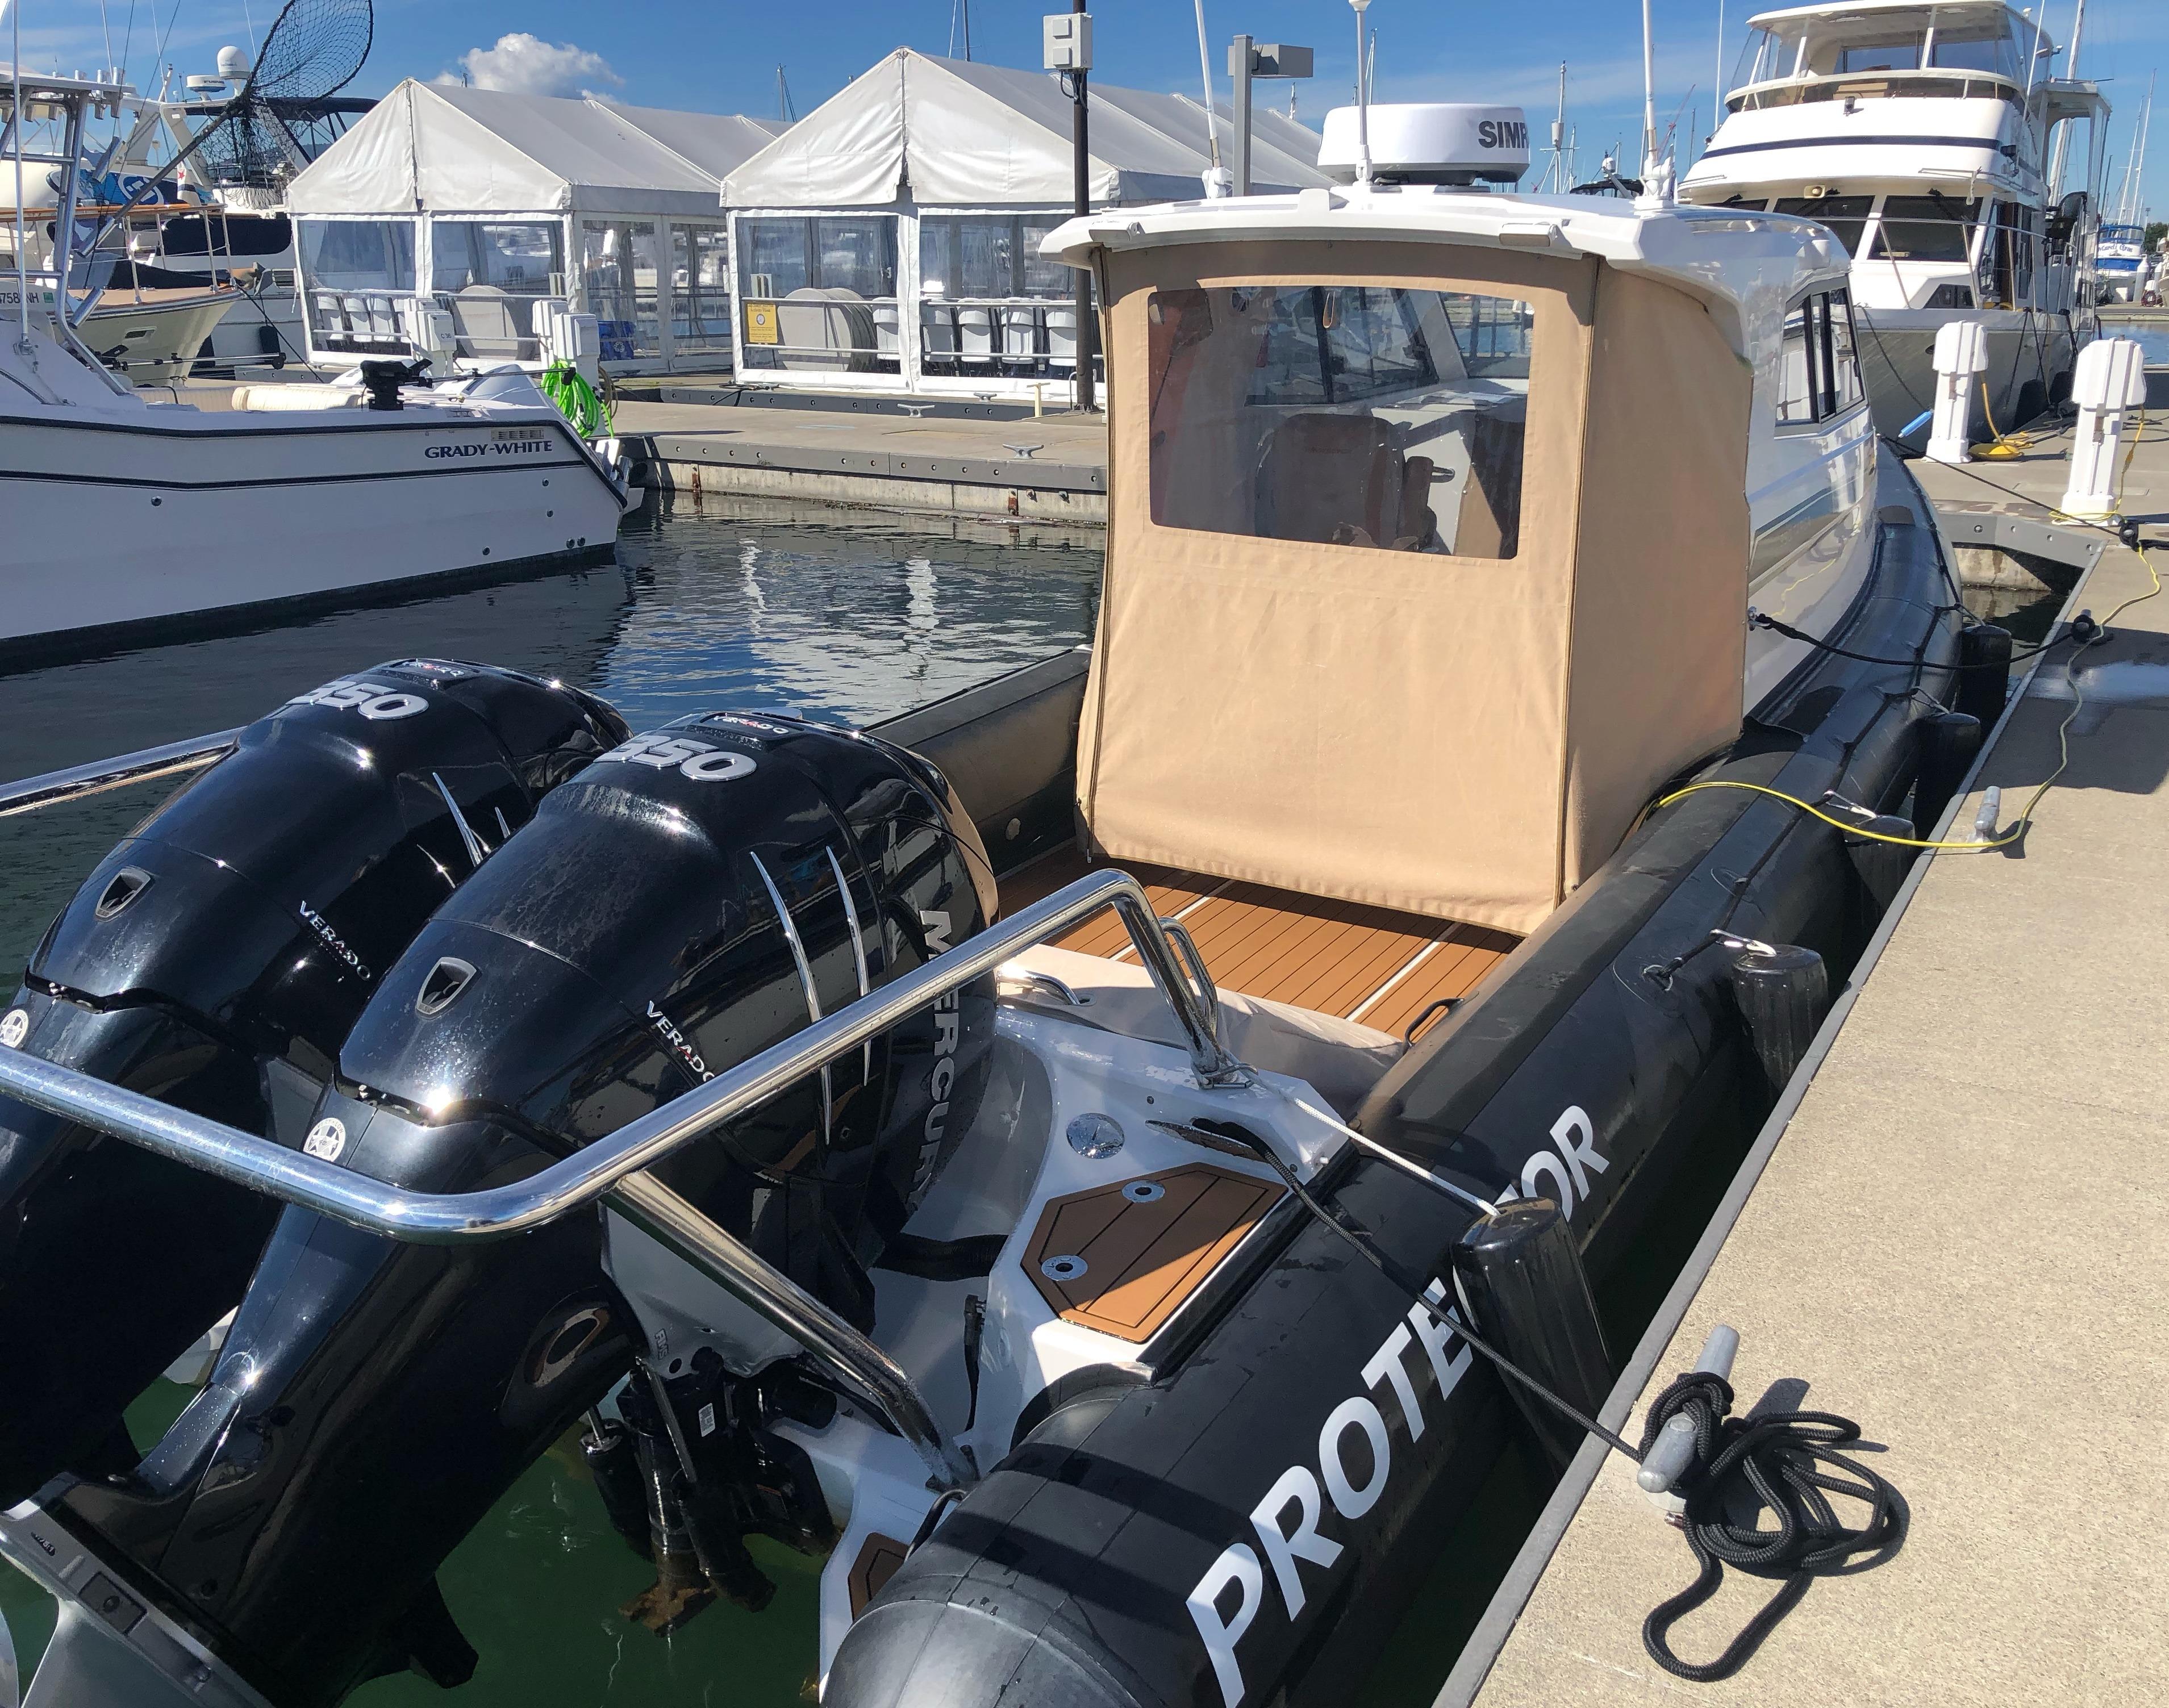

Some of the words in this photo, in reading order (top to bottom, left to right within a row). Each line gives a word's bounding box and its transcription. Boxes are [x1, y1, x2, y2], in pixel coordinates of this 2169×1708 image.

[0, 292, 20, 304] 758
[425, 440, 552, 459] GRADY-WHITE
[593, 735, 757, 782] 350
[300, 900, 371, 981] VERADO
[1186, 1105, 1610, 1707] PROTEOR
